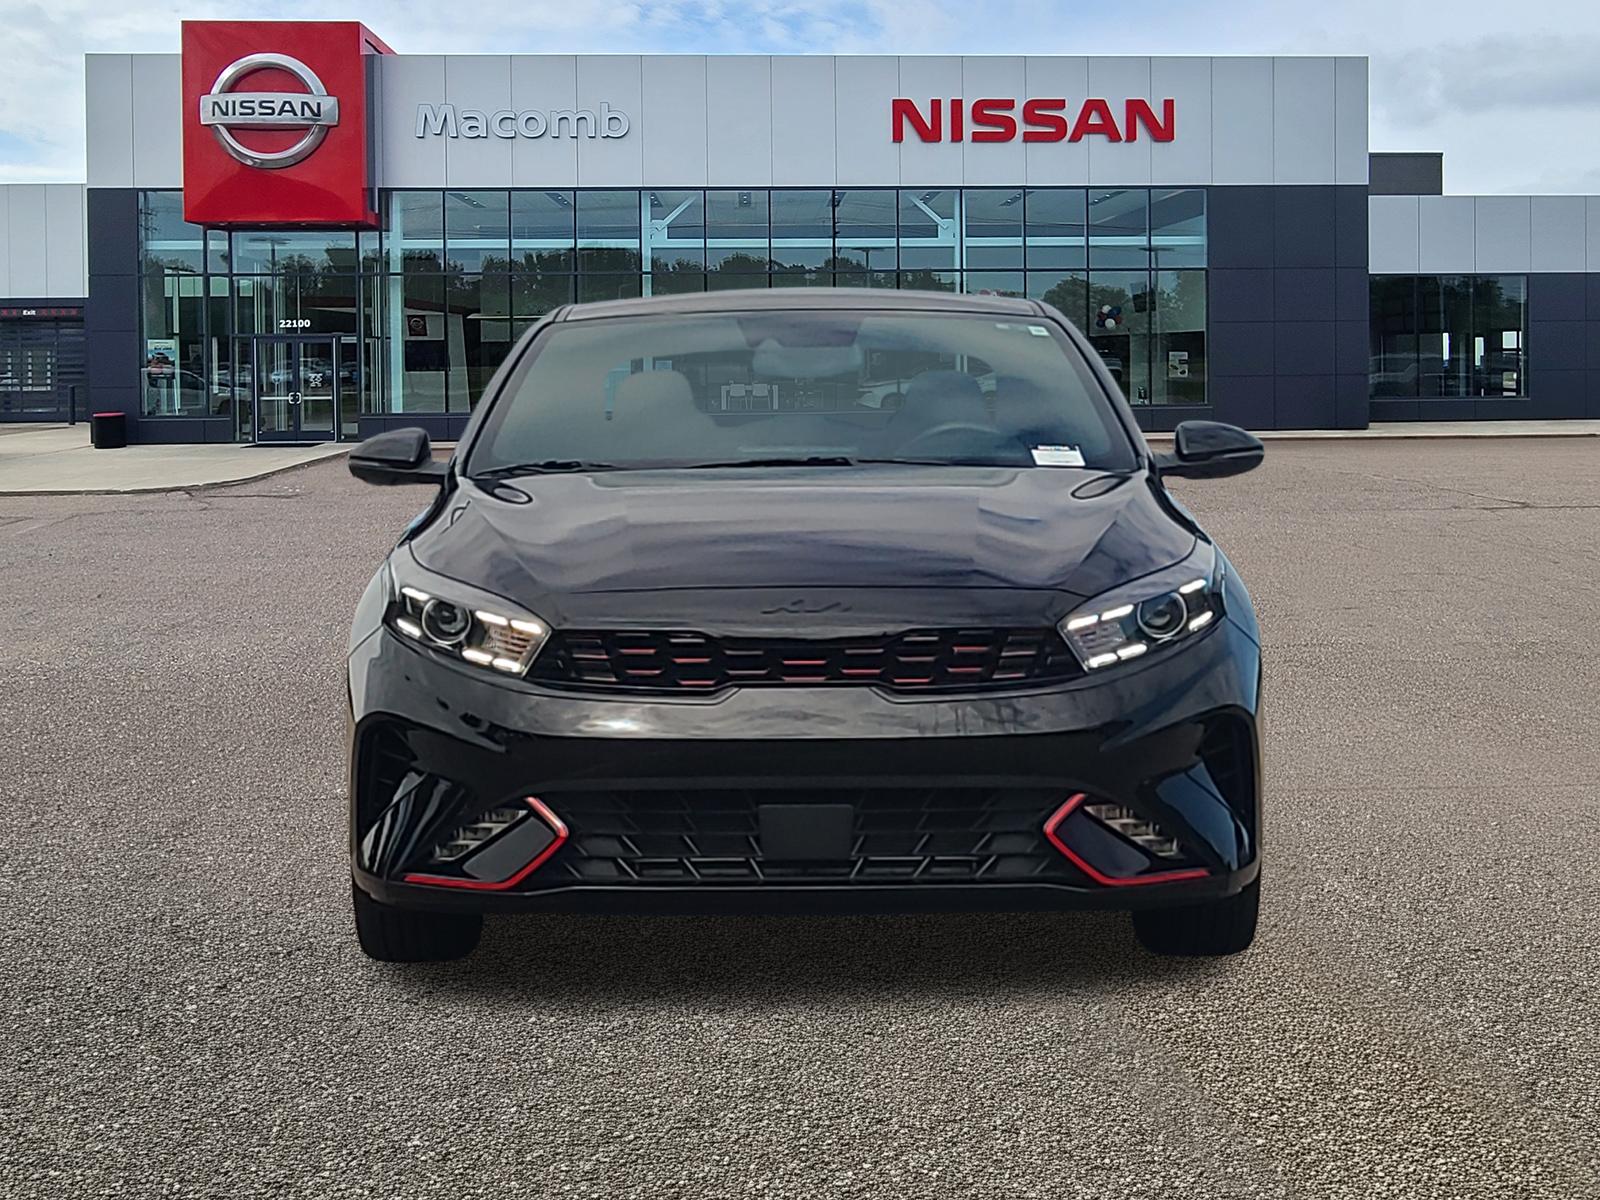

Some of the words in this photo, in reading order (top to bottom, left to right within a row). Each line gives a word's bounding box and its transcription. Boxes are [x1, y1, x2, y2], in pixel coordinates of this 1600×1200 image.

[211, 100, 322, 118] NISSAN
[415, 101, 631, 139] Macomb
[892, 98, 1176, 143] NISSAN
[279, 319, 311, 328] 22100
